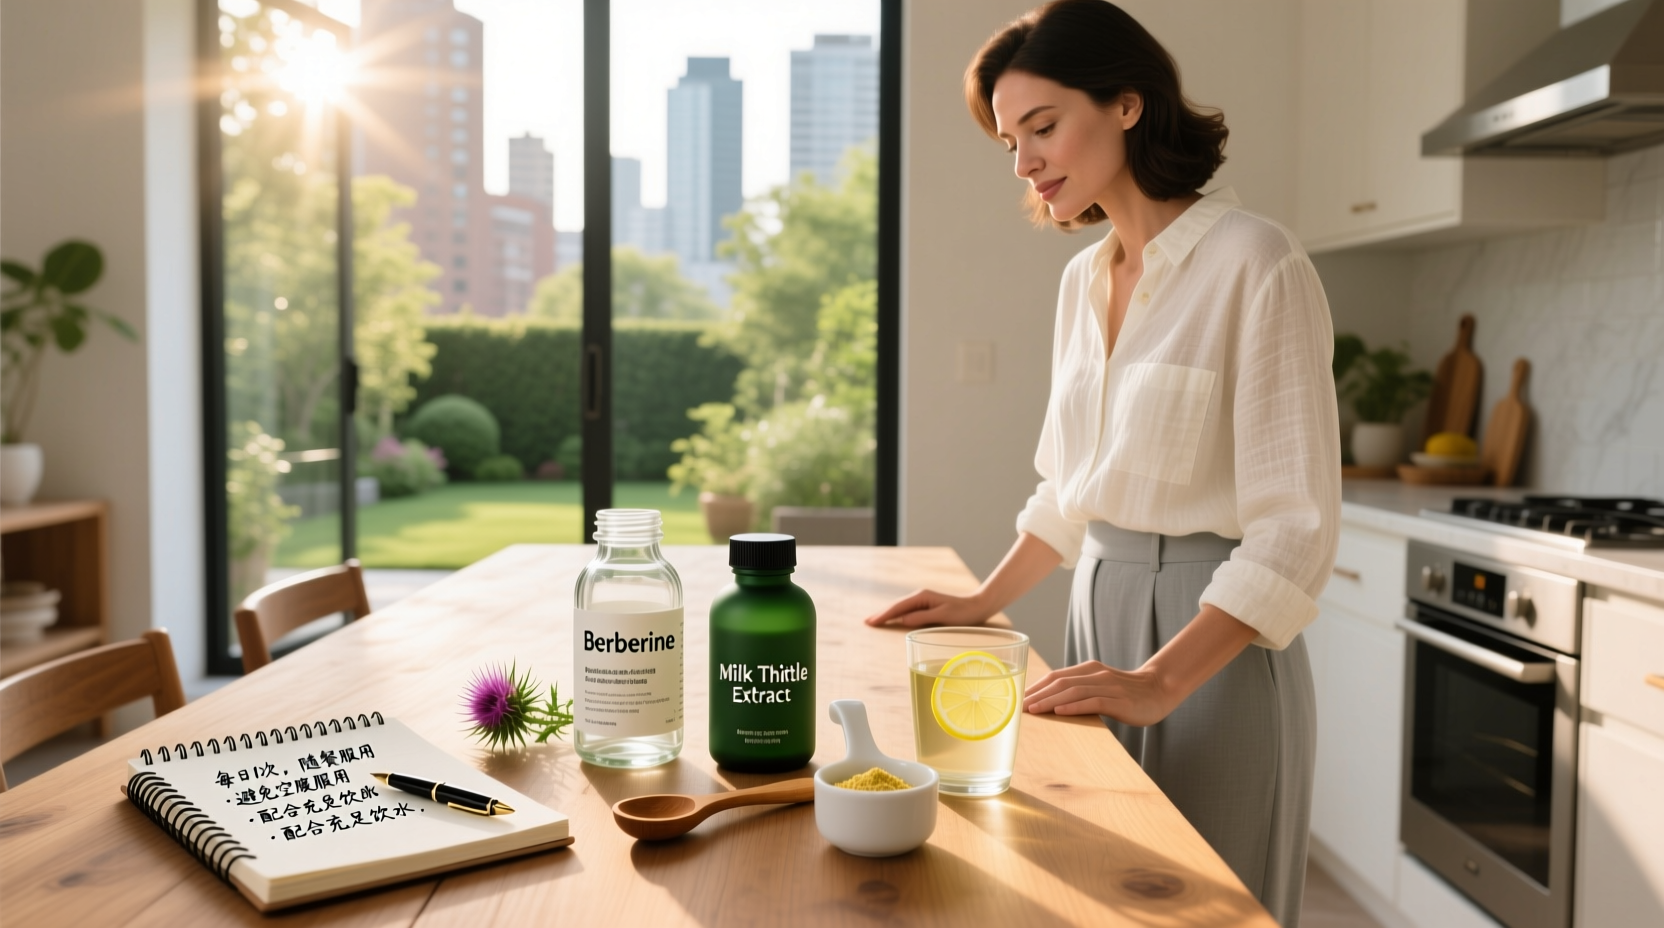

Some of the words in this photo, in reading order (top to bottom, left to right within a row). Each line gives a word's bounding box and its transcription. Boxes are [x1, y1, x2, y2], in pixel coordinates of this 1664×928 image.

[584, 630, 676, 653] Berberine
[719, 663, 753, 683] Milk
[732, 686, 792, 704] Extract
